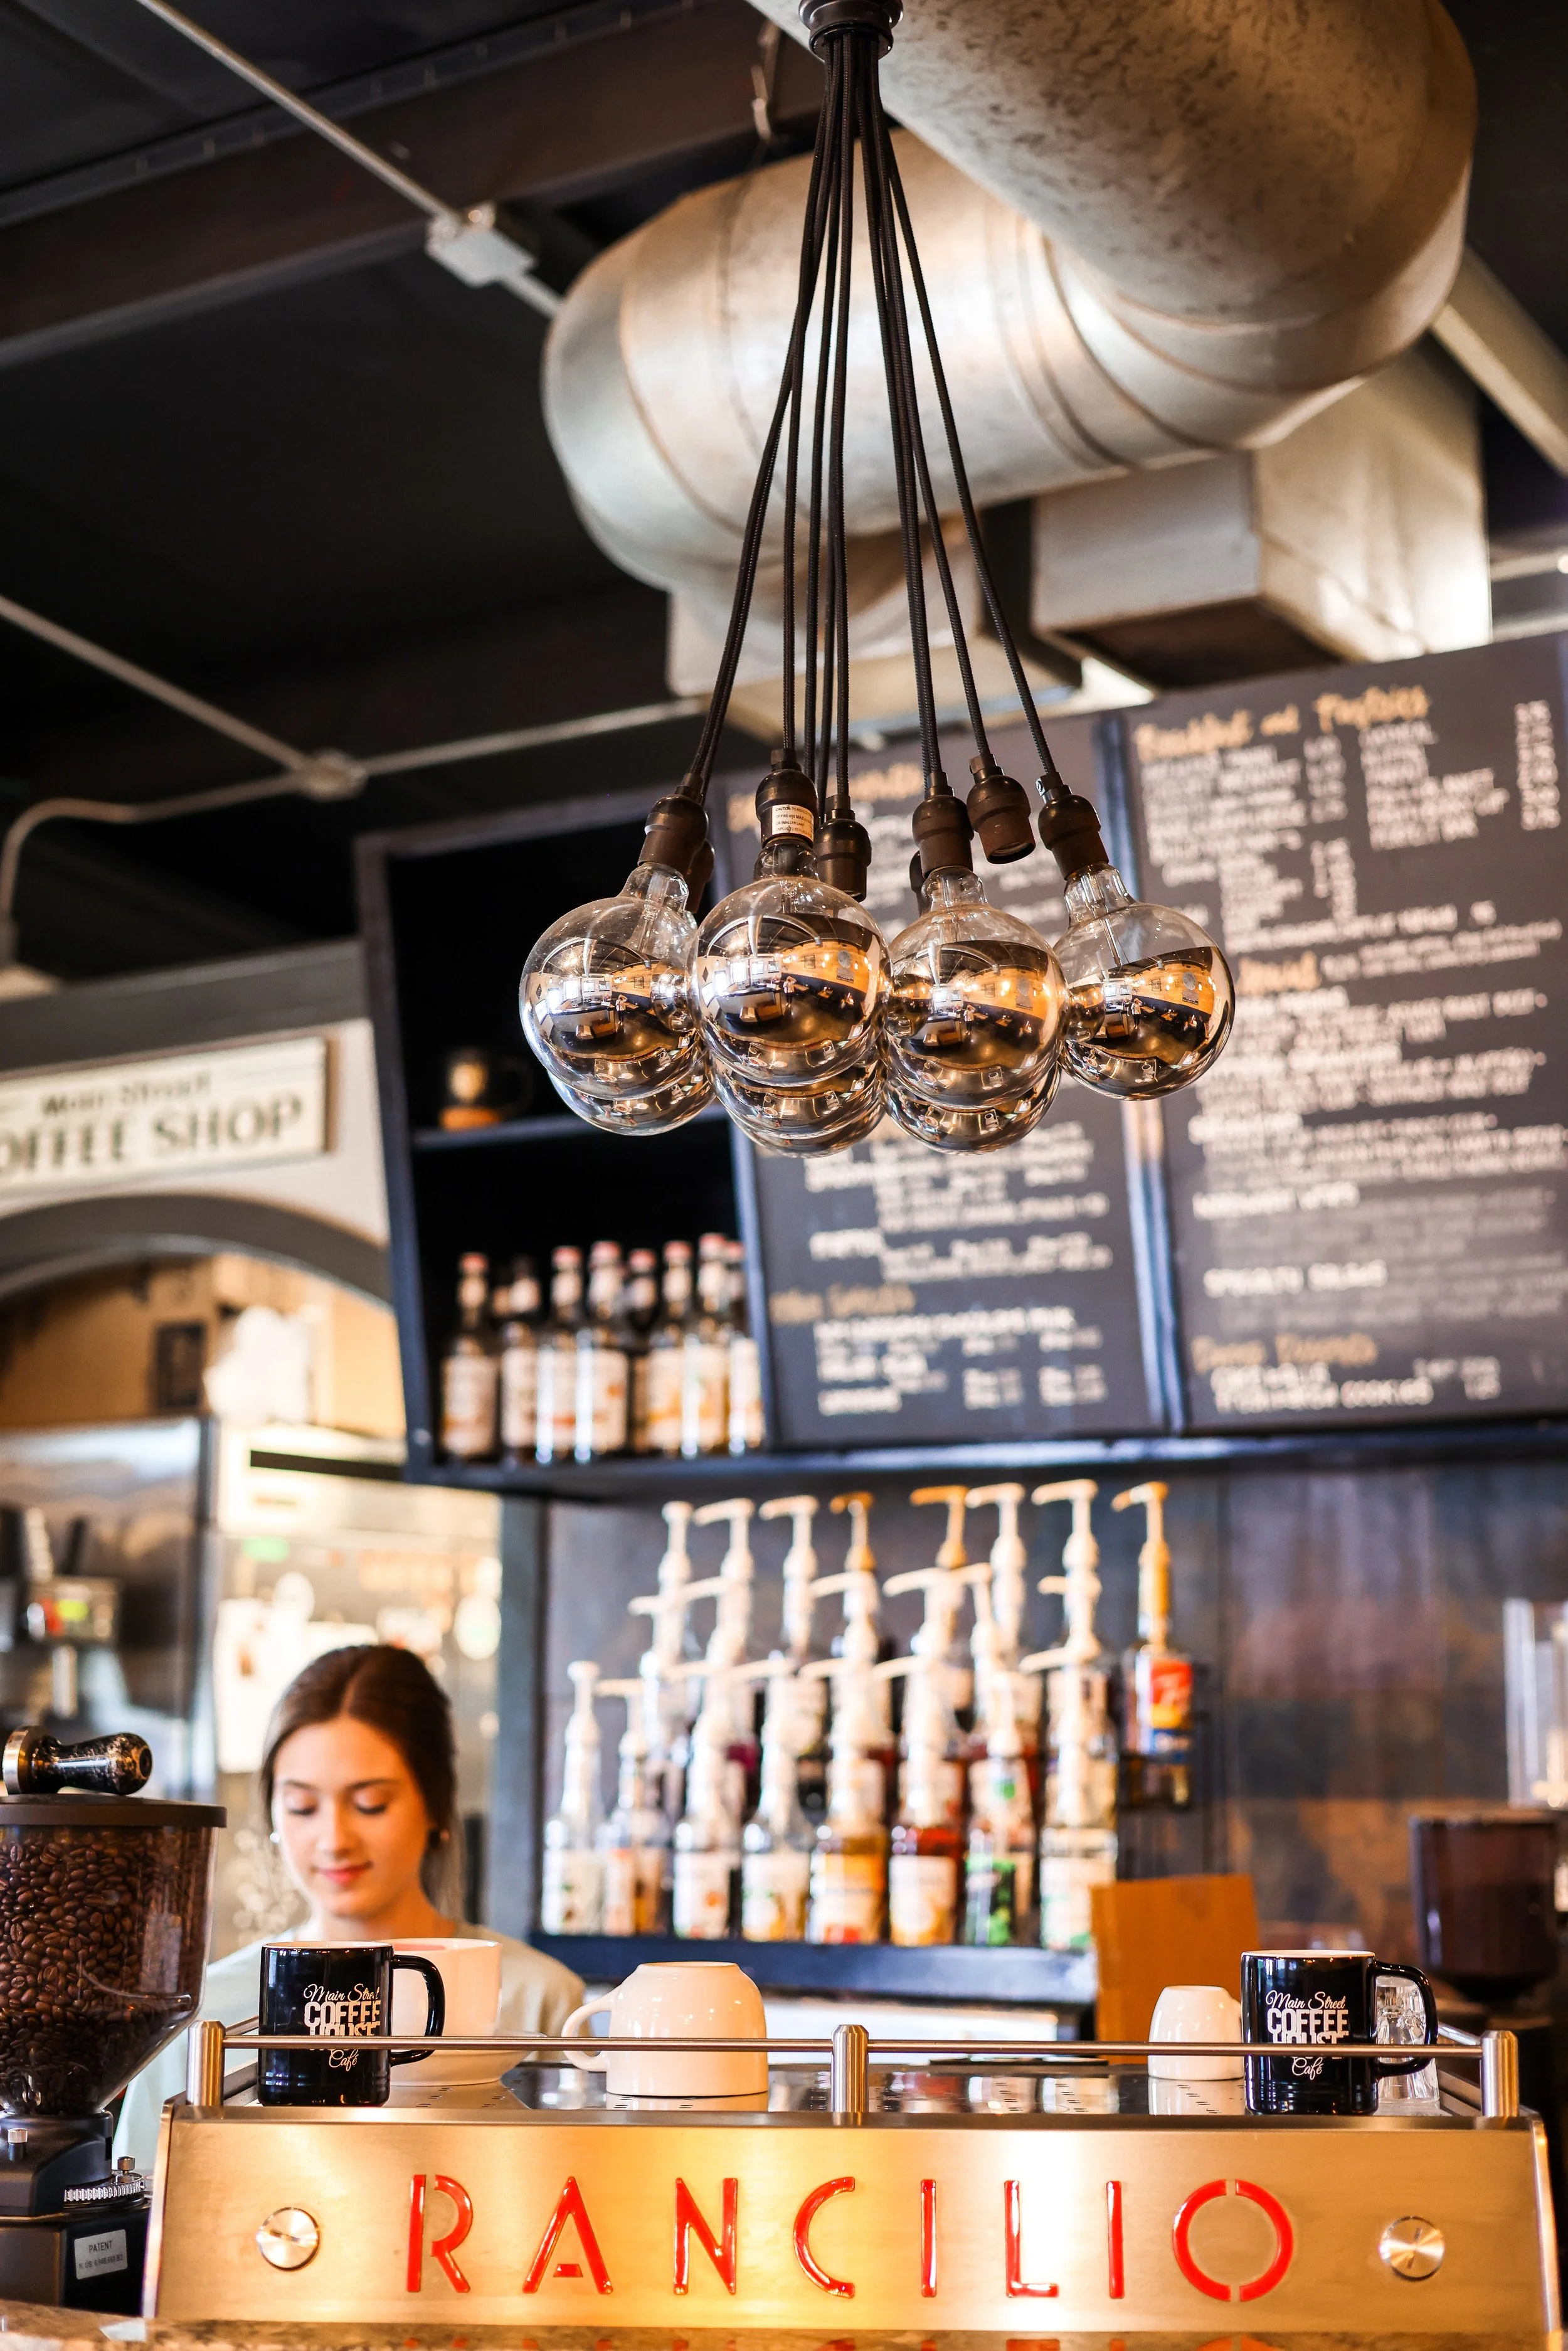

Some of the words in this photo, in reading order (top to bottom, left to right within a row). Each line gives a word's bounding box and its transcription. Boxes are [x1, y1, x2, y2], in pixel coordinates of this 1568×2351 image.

[153, 1090, 304, 1152] SHOP
[304, 1983, 345, 2002] Main
[1266, 1990, 1305, 2009] Main
[1308, 1992, 1346, 2010] Street
[304, 2001, 381, 2027] COFFEE
[1267, 2008, 1348, 2034] COFFEE
[329, 2050, 358, 2071] Café
[1291, 2057, 1323, 2080] Café
[88, 2240, 112, 2253] PATENT
[405, 2173, 1295, 2303] RANCILIO
